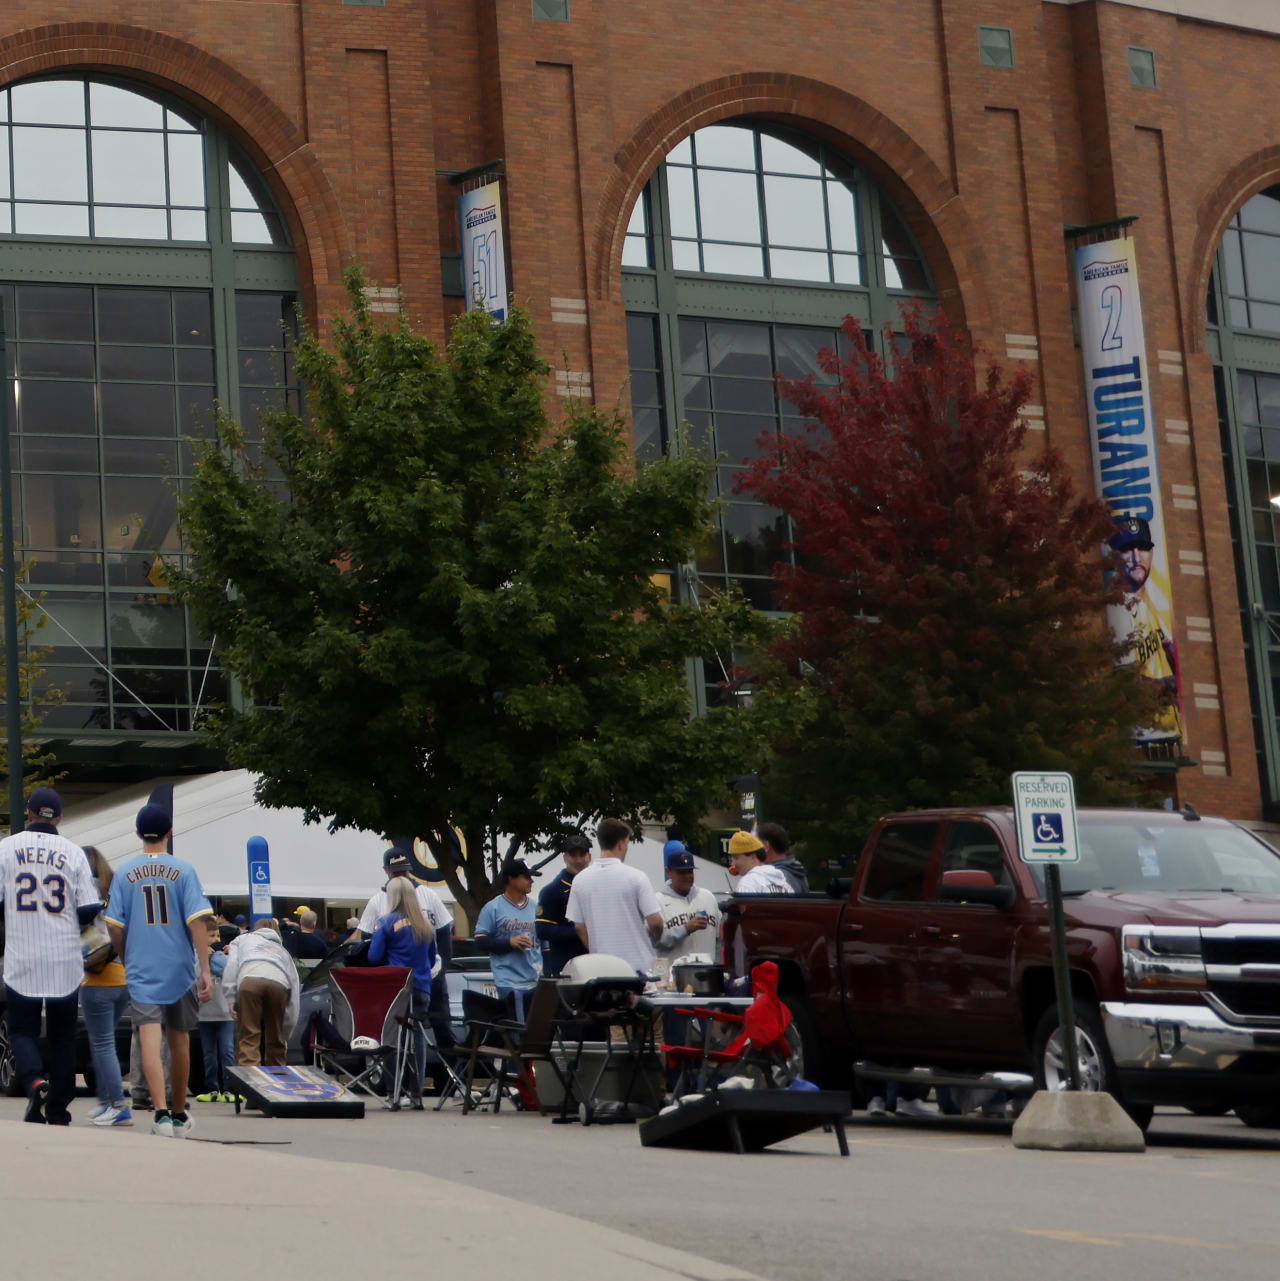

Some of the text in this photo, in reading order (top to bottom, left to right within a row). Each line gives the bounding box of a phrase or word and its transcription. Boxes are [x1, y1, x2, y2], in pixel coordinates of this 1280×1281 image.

[473, 230, 498, 302] 51
[1101, 284, 1123, 352] 2
[1019, 782, 1068, 793] RESERVED
[1024, 797, 1066, 808] PARKING
[14, 846, 67, 870] WEEKS
[126, 864, 180, 884] CHOURIO
[14, 871, 67, 914] 23
[141, 883, 169, 926] 11
[665, 912, 716, 930] BREWRS
